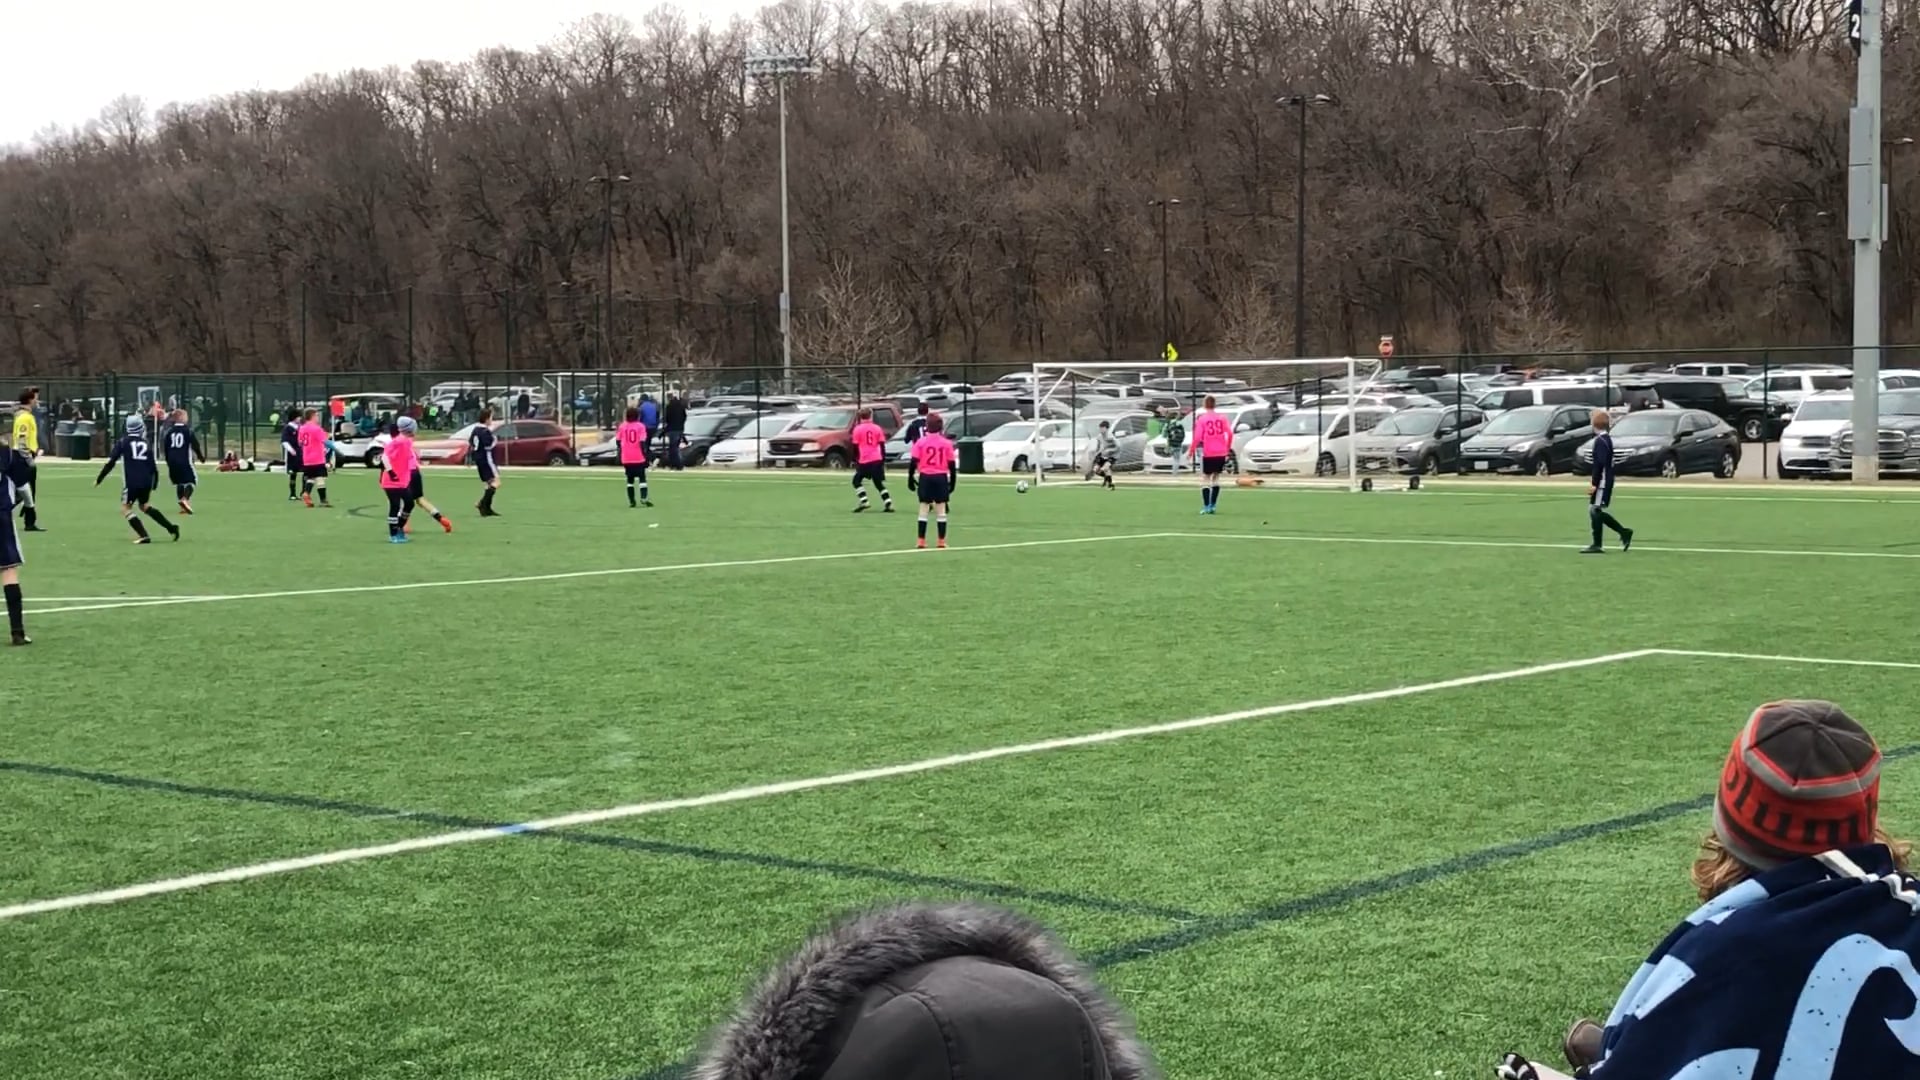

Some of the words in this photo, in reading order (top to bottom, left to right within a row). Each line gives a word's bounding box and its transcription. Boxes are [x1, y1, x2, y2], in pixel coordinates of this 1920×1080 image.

[1851, 14, 1860, 39] 2
[171, 432, 184, 448] 10
[625, 429, 637, 444] 10
[130, 441, 148, 460] 12
[926, 446, 944, 466] 21
